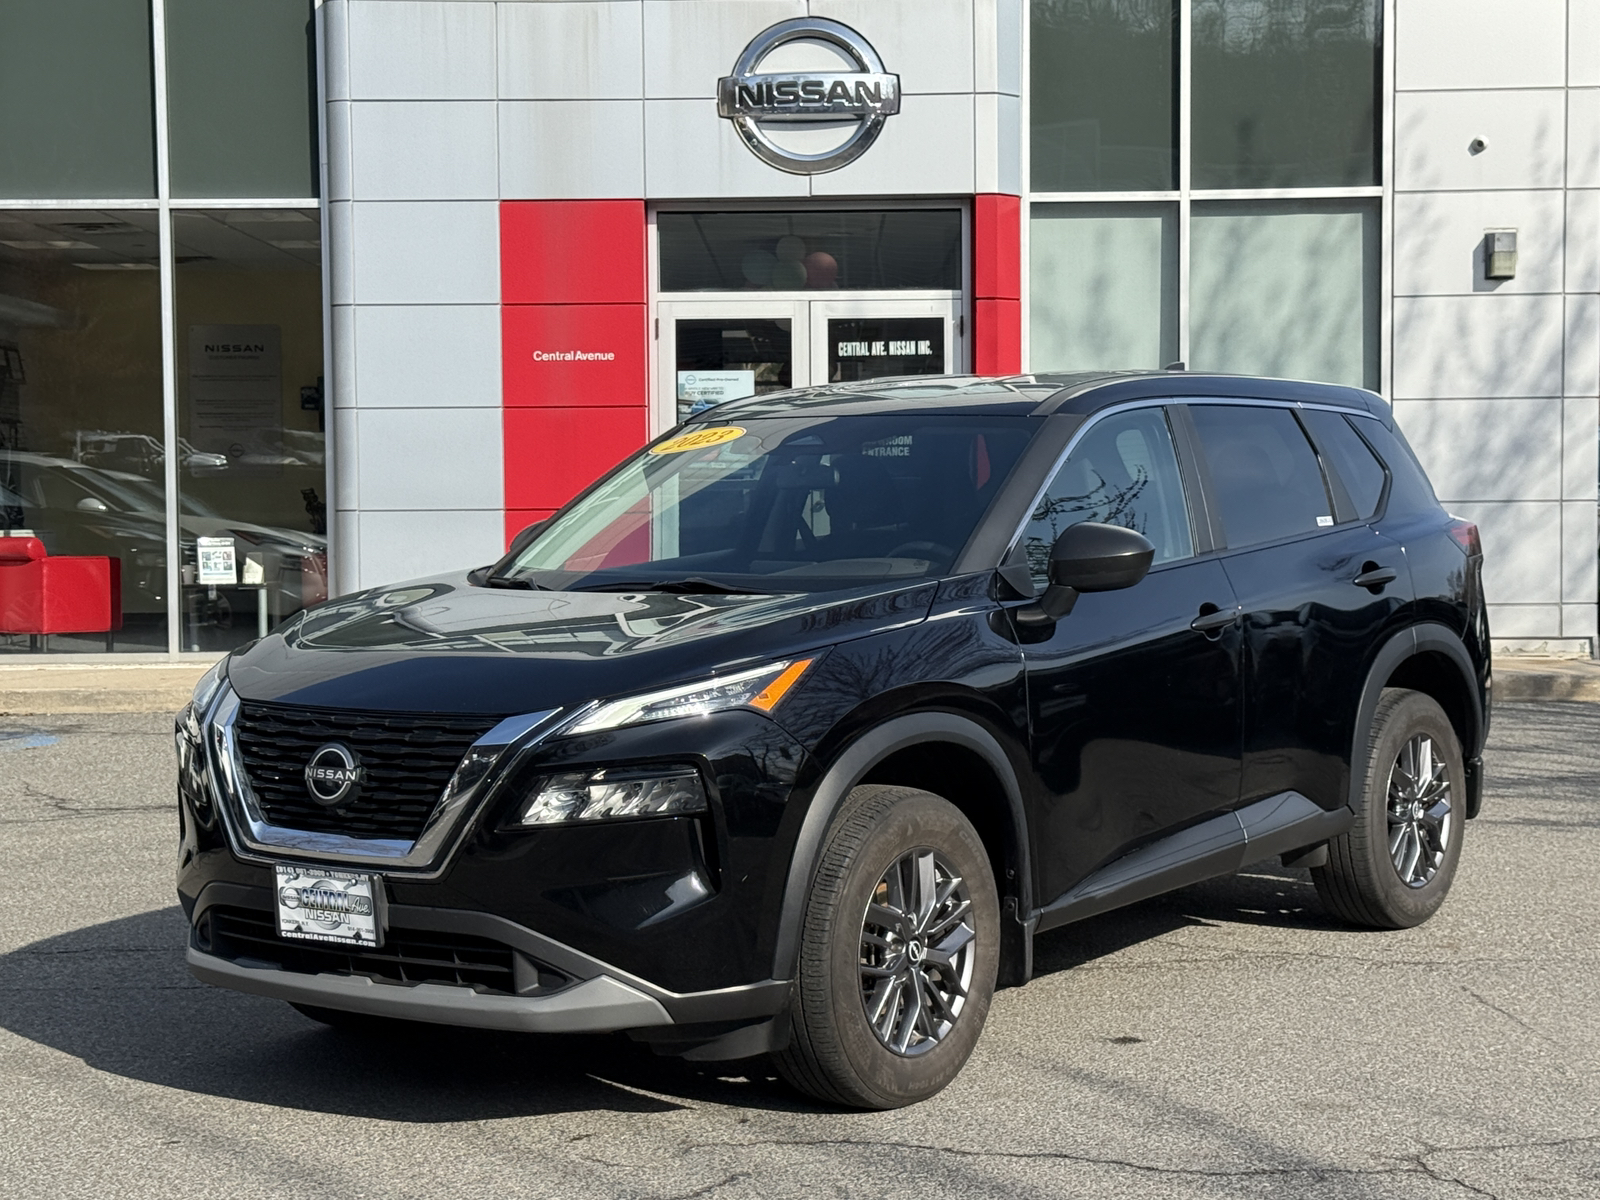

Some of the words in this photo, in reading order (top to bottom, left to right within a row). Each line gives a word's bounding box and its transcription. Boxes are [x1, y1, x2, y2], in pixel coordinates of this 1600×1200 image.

[735, 80, 882, 107] NISSAN
[204, 344, 265, 353] NISSAN
[532, 350, 574, 361] Central
[575, 350, 615, 361] Avenue
[838, 341, 869, 356] CENTRAL
[871, 341, 887, 356] AVE.
[889, 340, 916, 355] NISSAN
[918, 340, 932, 355] INC.
[660, 430, 734, 452] 2023
[305, 767, 356, 780] NISSAN
[301, 887, 350, 912] CENTRAL
[350, 896, 371, 914] Ave.
[304, 909, 350, 924] NISSAN
[281, 931, 376, 947] CentralAveNissan.com
